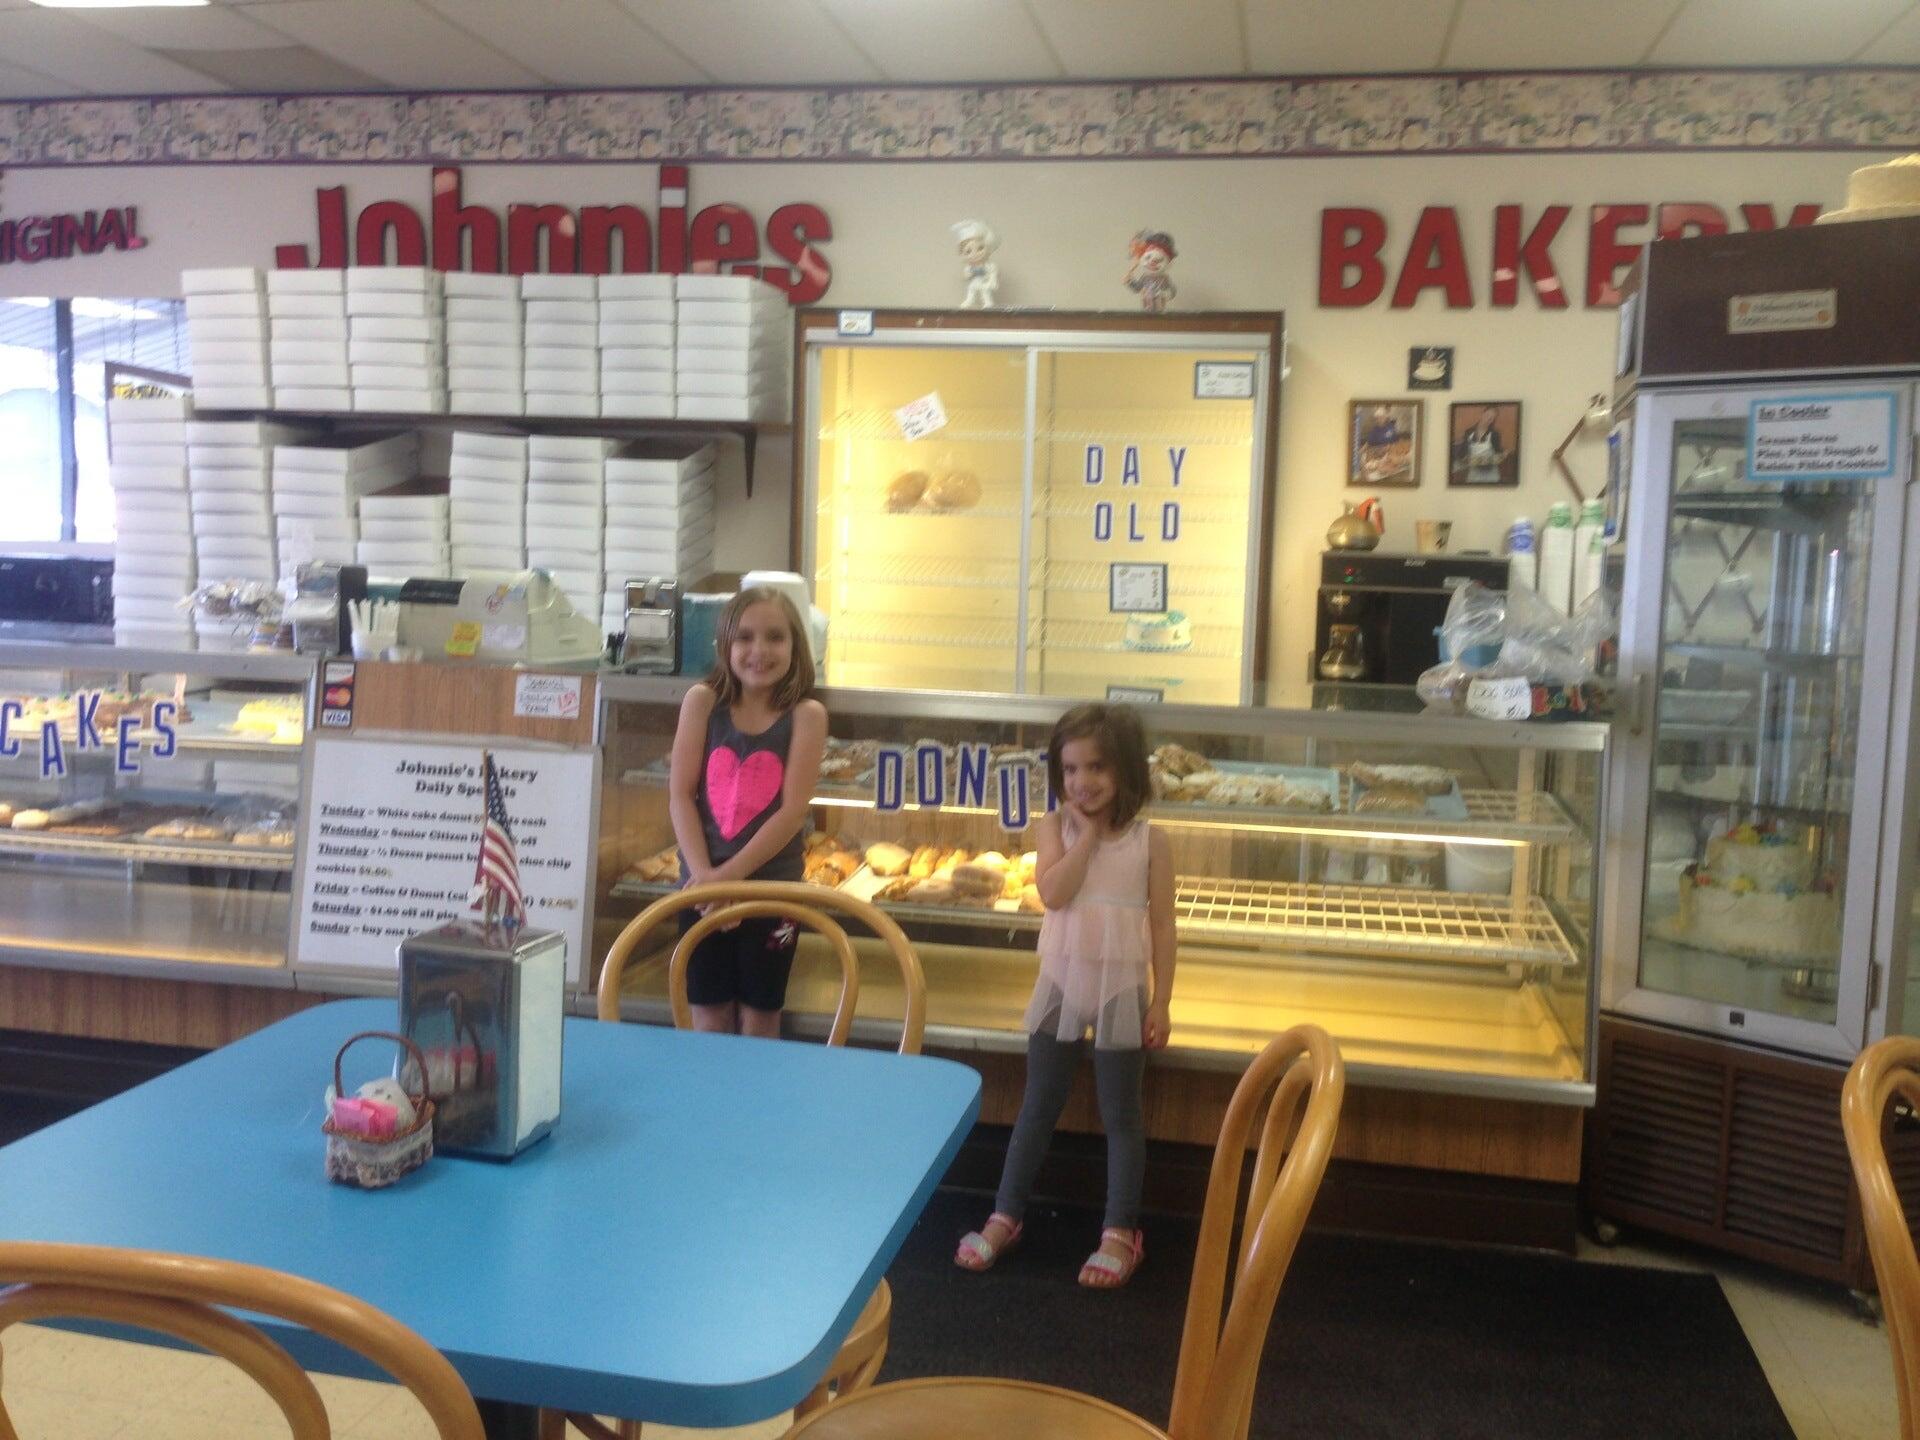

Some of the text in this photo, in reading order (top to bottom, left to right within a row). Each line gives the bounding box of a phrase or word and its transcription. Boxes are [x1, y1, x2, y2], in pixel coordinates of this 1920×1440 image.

[276, 165, 1822, 309] Johnnies BAKE
[1085, 444, 1187, 487] DAY
[1093, 501, 1181, 542] OLD
[0, 692, 177, 777] CAKES
[395, 759, 539, 784] Johnnie's kery
[414, 779, 517, 798] Daily Spels
[320, 803, 366, 819] Tuesday
[377, 806, 409, 818] White
[411, 809, 437, 820] cake
[439, 810, 472, 822] donut
[521, 816, 547, 827] each
[319, 822, 380, 839] Wednesday
[391, 827, 426, 840] Senior
[429, 829, 468, 842] Citizen
[521, 835, 538, 847] off
[315, 863, 357, 876] cookies
[317, 843, 369, 859] Thursday
[389, 846, 424, 859] Dozen
[425, 849, 464, 862] peanut
[519, 856, 545, 867] choc
[547, 858, 572, 871] chip
[313, 881, 350, 896] Friday
[361, 884, 396, 897] Coffee
[410, 887, 445, 900] Donut
[311, 900, 362, 916] Saturday
[401, 907, 418, 918] off
[419, 908, 435, 919] all
[436, 909, 459, 922] pies
[310, 920, 351, 935] Sunday
[362, 923, 383, 937] buy
[384, 926, 407, 936] one
